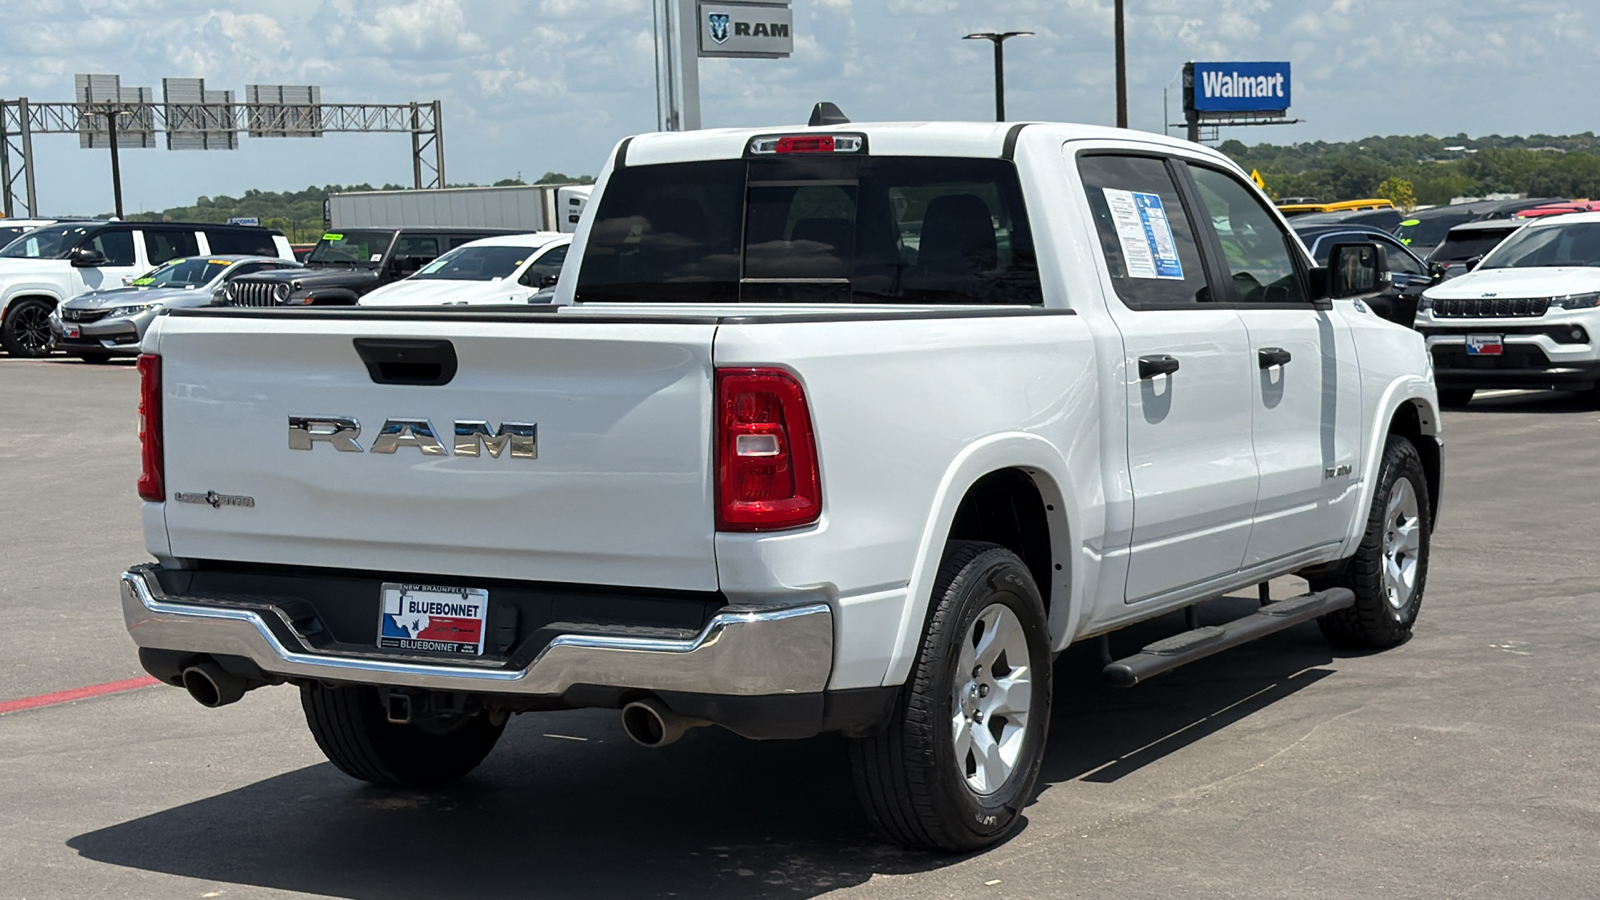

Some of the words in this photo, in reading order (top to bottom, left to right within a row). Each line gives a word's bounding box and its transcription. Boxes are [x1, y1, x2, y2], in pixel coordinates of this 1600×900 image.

[734, 21, 789, 38] RAM
[1202, 71, 1284, 98] Walmart
[287, 413, 539, 460] RAM
[423, 585, 465, 593] BRAUNFELS
[409, 601, 479, 617] BLUEBONNET
[400, 640, 458, 652] BLUEBONNET
